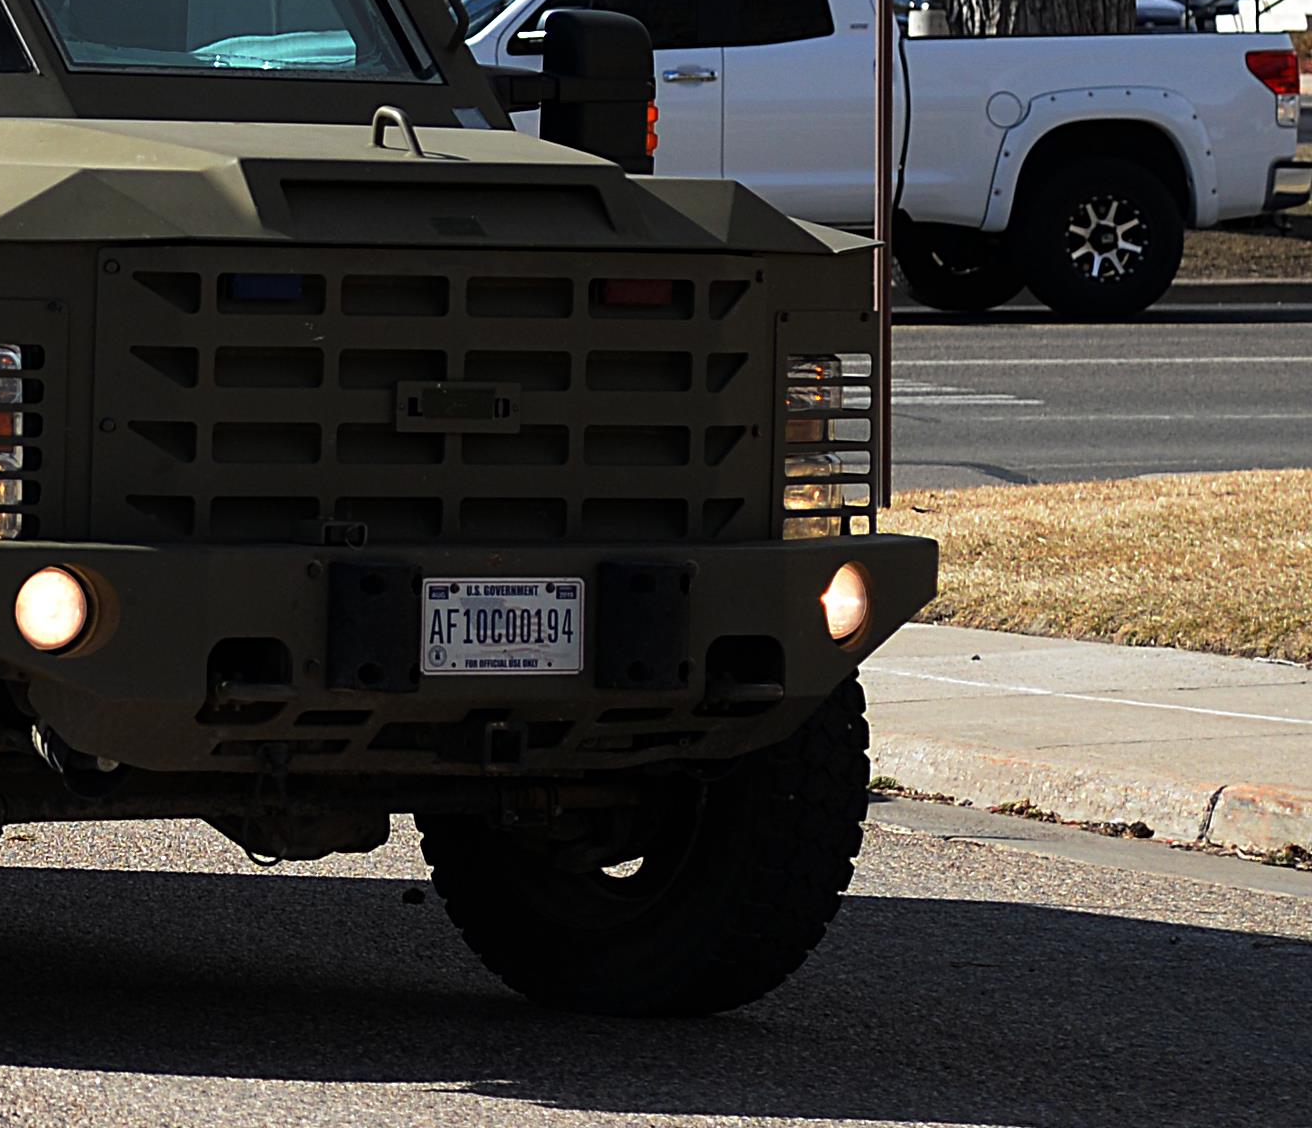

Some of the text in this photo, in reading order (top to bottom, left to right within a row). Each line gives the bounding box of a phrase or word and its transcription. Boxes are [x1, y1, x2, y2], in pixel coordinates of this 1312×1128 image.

[466, 584, 539, 596] U.S. GOVERNMENT
[429, 608, 574, 644] AF10C00194
[465, 659, 478, 668] FOR
[479, 659, 507, 668] OFFICIAL
